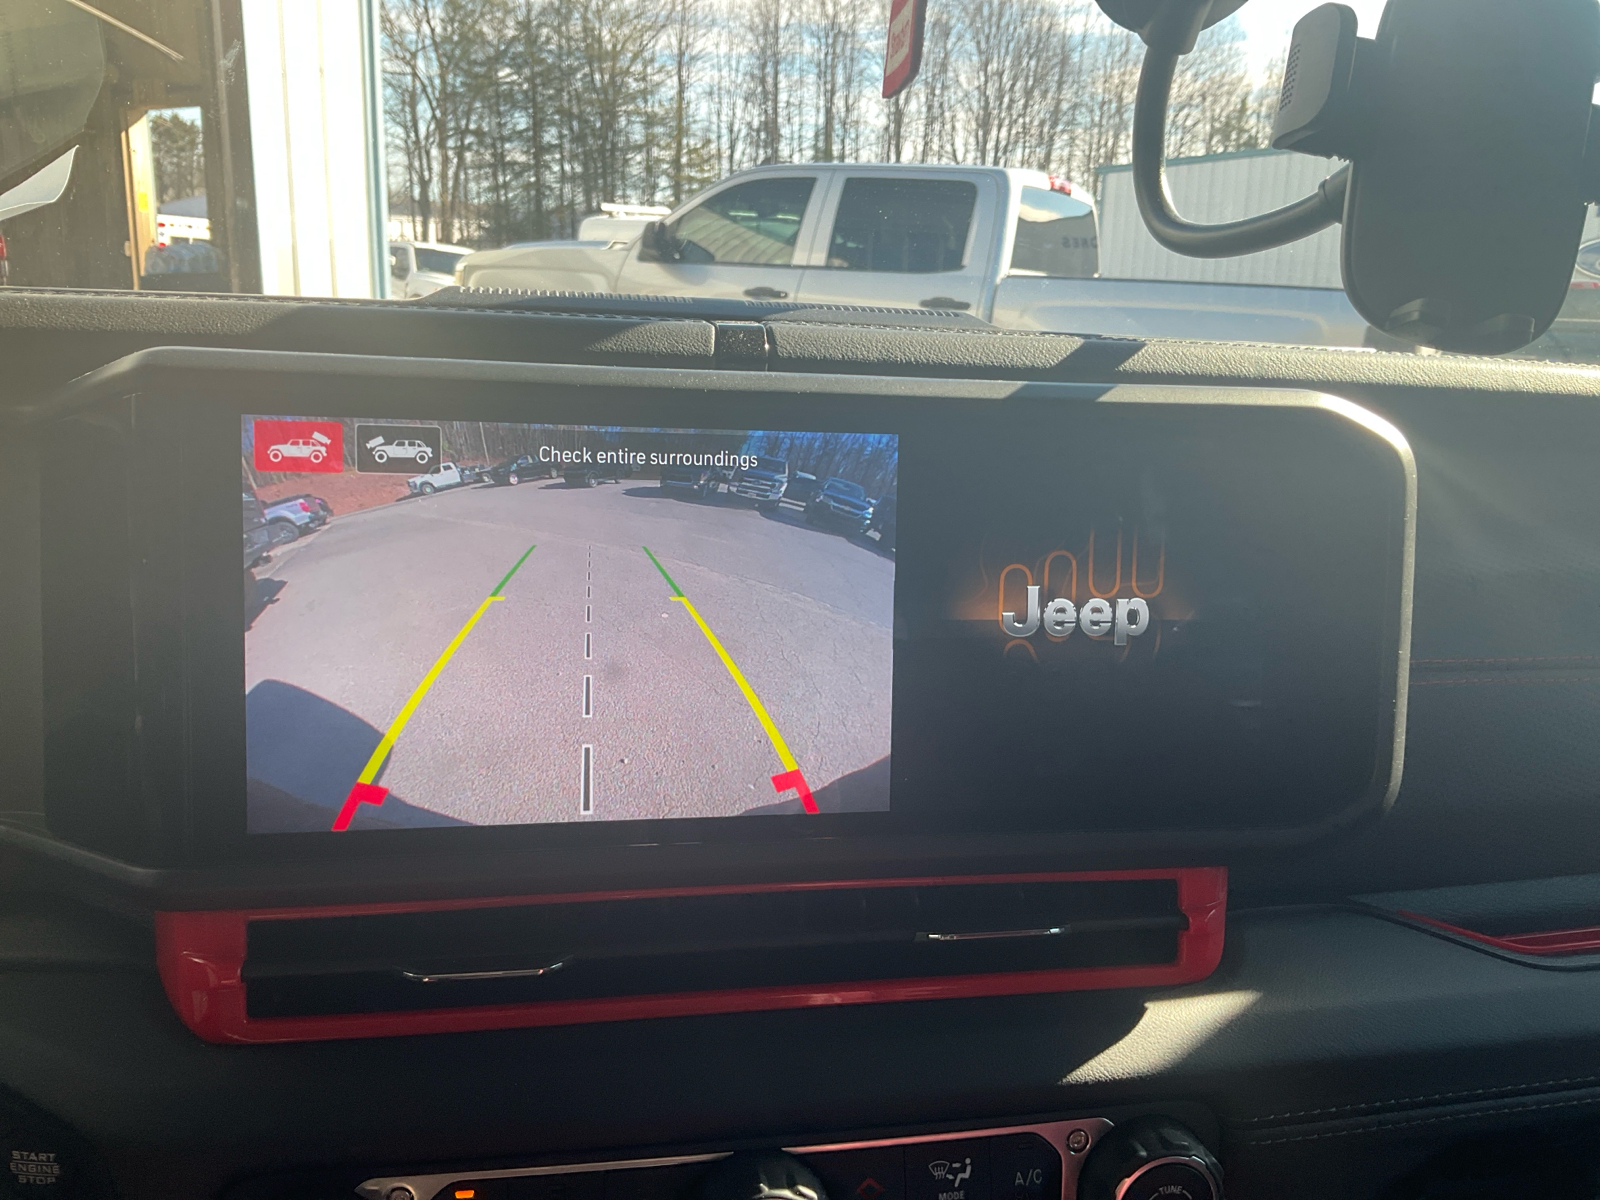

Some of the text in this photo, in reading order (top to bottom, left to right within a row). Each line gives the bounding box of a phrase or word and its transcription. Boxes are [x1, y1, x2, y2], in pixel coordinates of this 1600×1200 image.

[538, 446, 758, 471] Check entire surroundings
[1001, 585, 1150, 646] Jeep
[11, 1150, 56, 1162] START
[9, 1162, 60, 1174] ENGINE
[18, 1175, 56, 1185] STOP
[1014, 1168, 1043, 1186] A/C
[938, 1190, 965, 1200] MODE
[1158, 1185, 1183, 1195] TUNE
